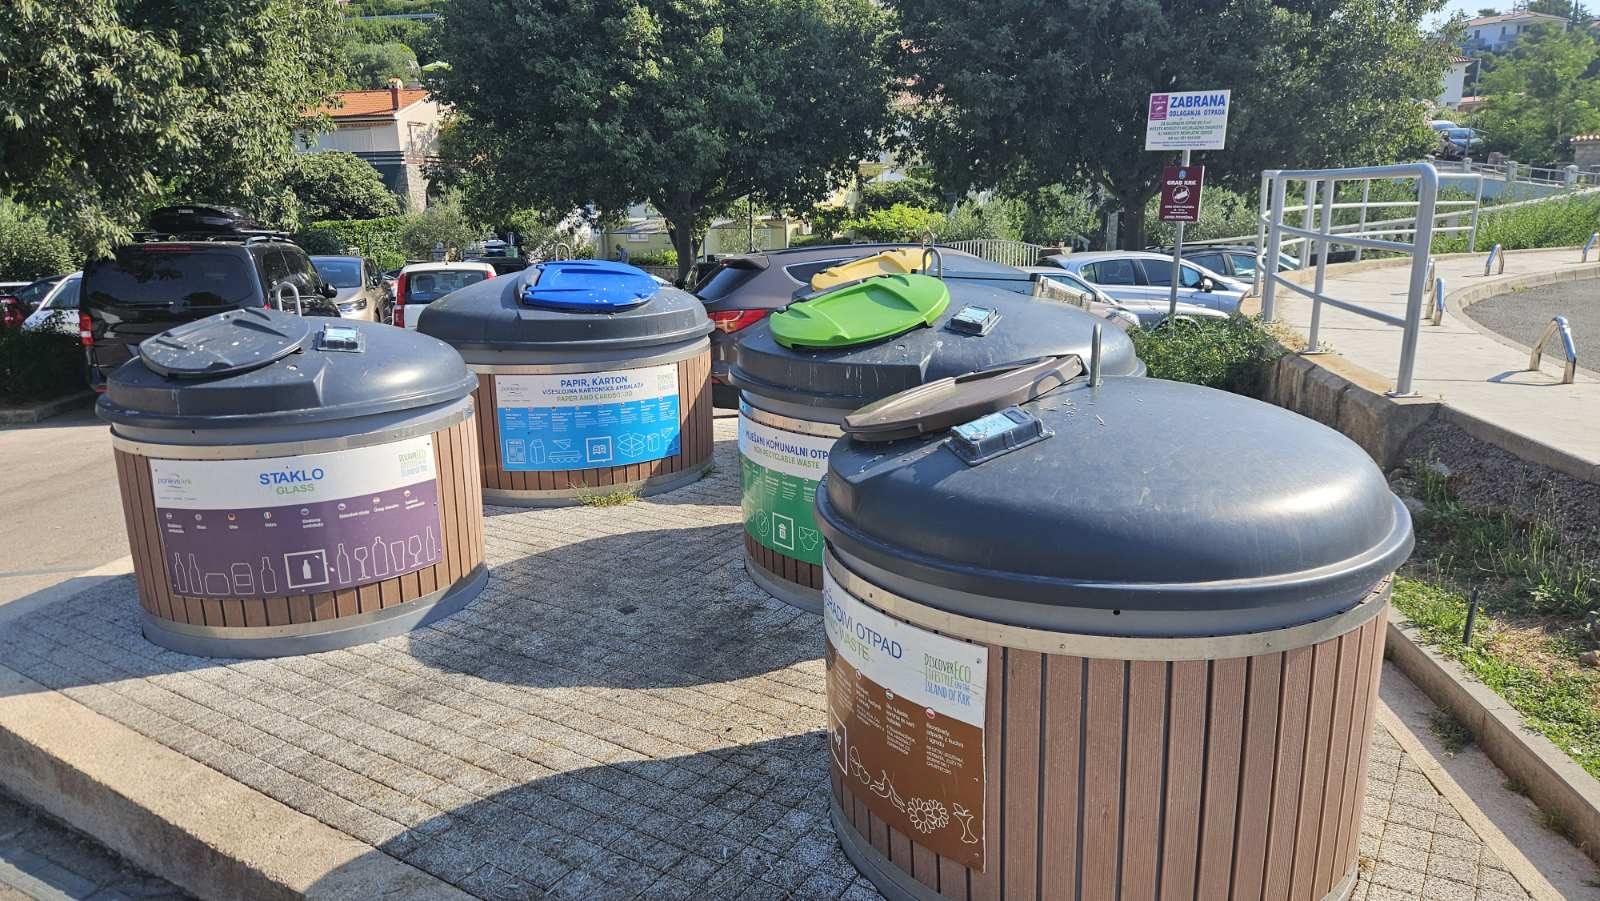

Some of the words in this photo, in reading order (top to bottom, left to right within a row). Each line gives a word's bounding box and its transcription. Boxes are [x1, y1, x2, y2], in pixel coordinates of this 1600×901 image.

[1170, 94, 1226, 108] ZABRANA
[560, 378, 590, 388] PAPIR,
[591, 375, 628, 386] KARTON
[556, 393, 577, 402] PAPER
[578, 393, 593, 401] AND
[766, 439, 808, 457] KOMUNALNI
[810, 448, 830, 460] OTP
[796, 456, 821, 469] WASTE
[259, 468, 325, 486] STAKLO
[276, 483, 315, 496] GLASS
[856, 623, 903, 660] OTPAD
